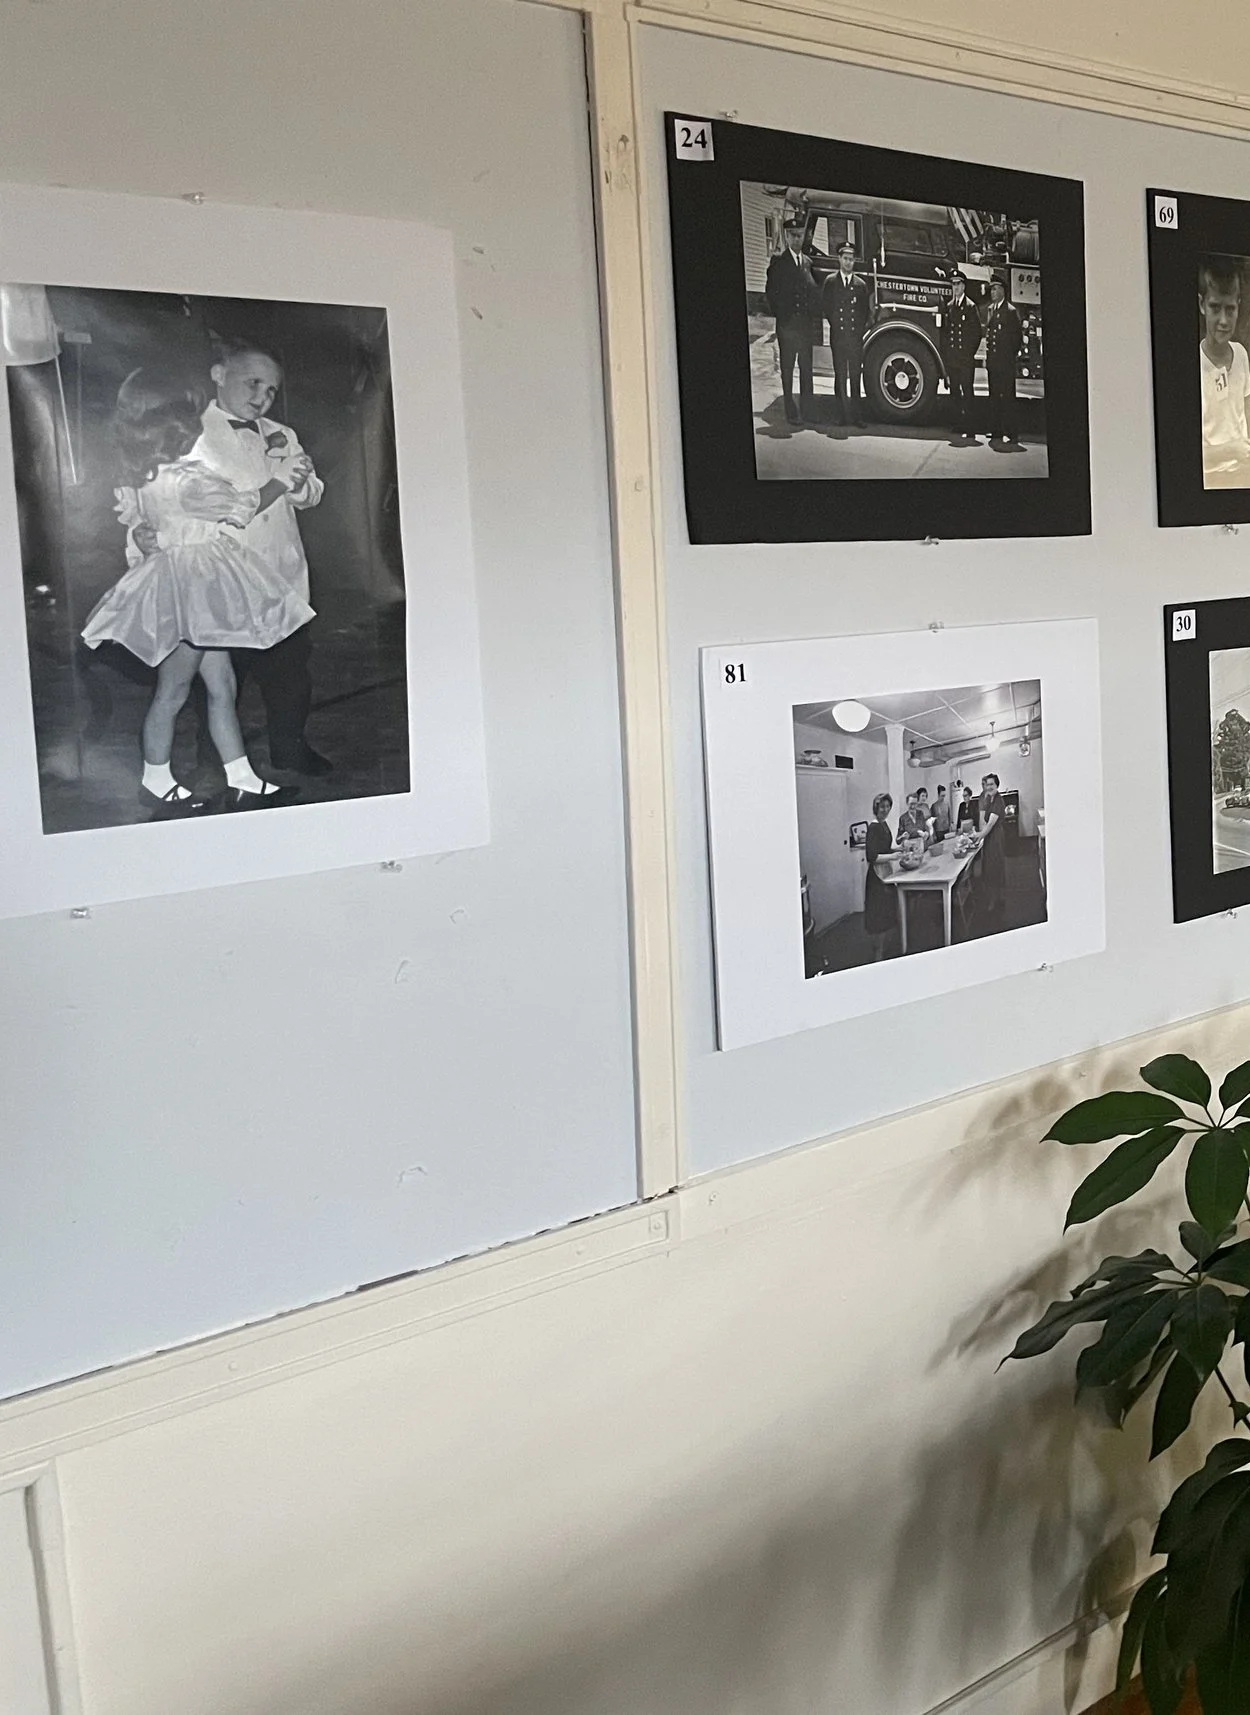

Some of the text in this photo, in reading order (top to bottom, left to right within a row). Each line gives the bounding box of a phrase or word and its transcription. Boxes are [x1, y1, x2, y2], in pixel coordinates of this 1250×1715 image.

[681, 127, 708, 149] 24
[1159, 206, 1174, 224] 69
[877, 280, 919, 292] CHESTERTOWN
[903, 293, 916, 302] FIRE
[1176, 615, 1192, 632] 30
[725, 663, 746, 684] 81
